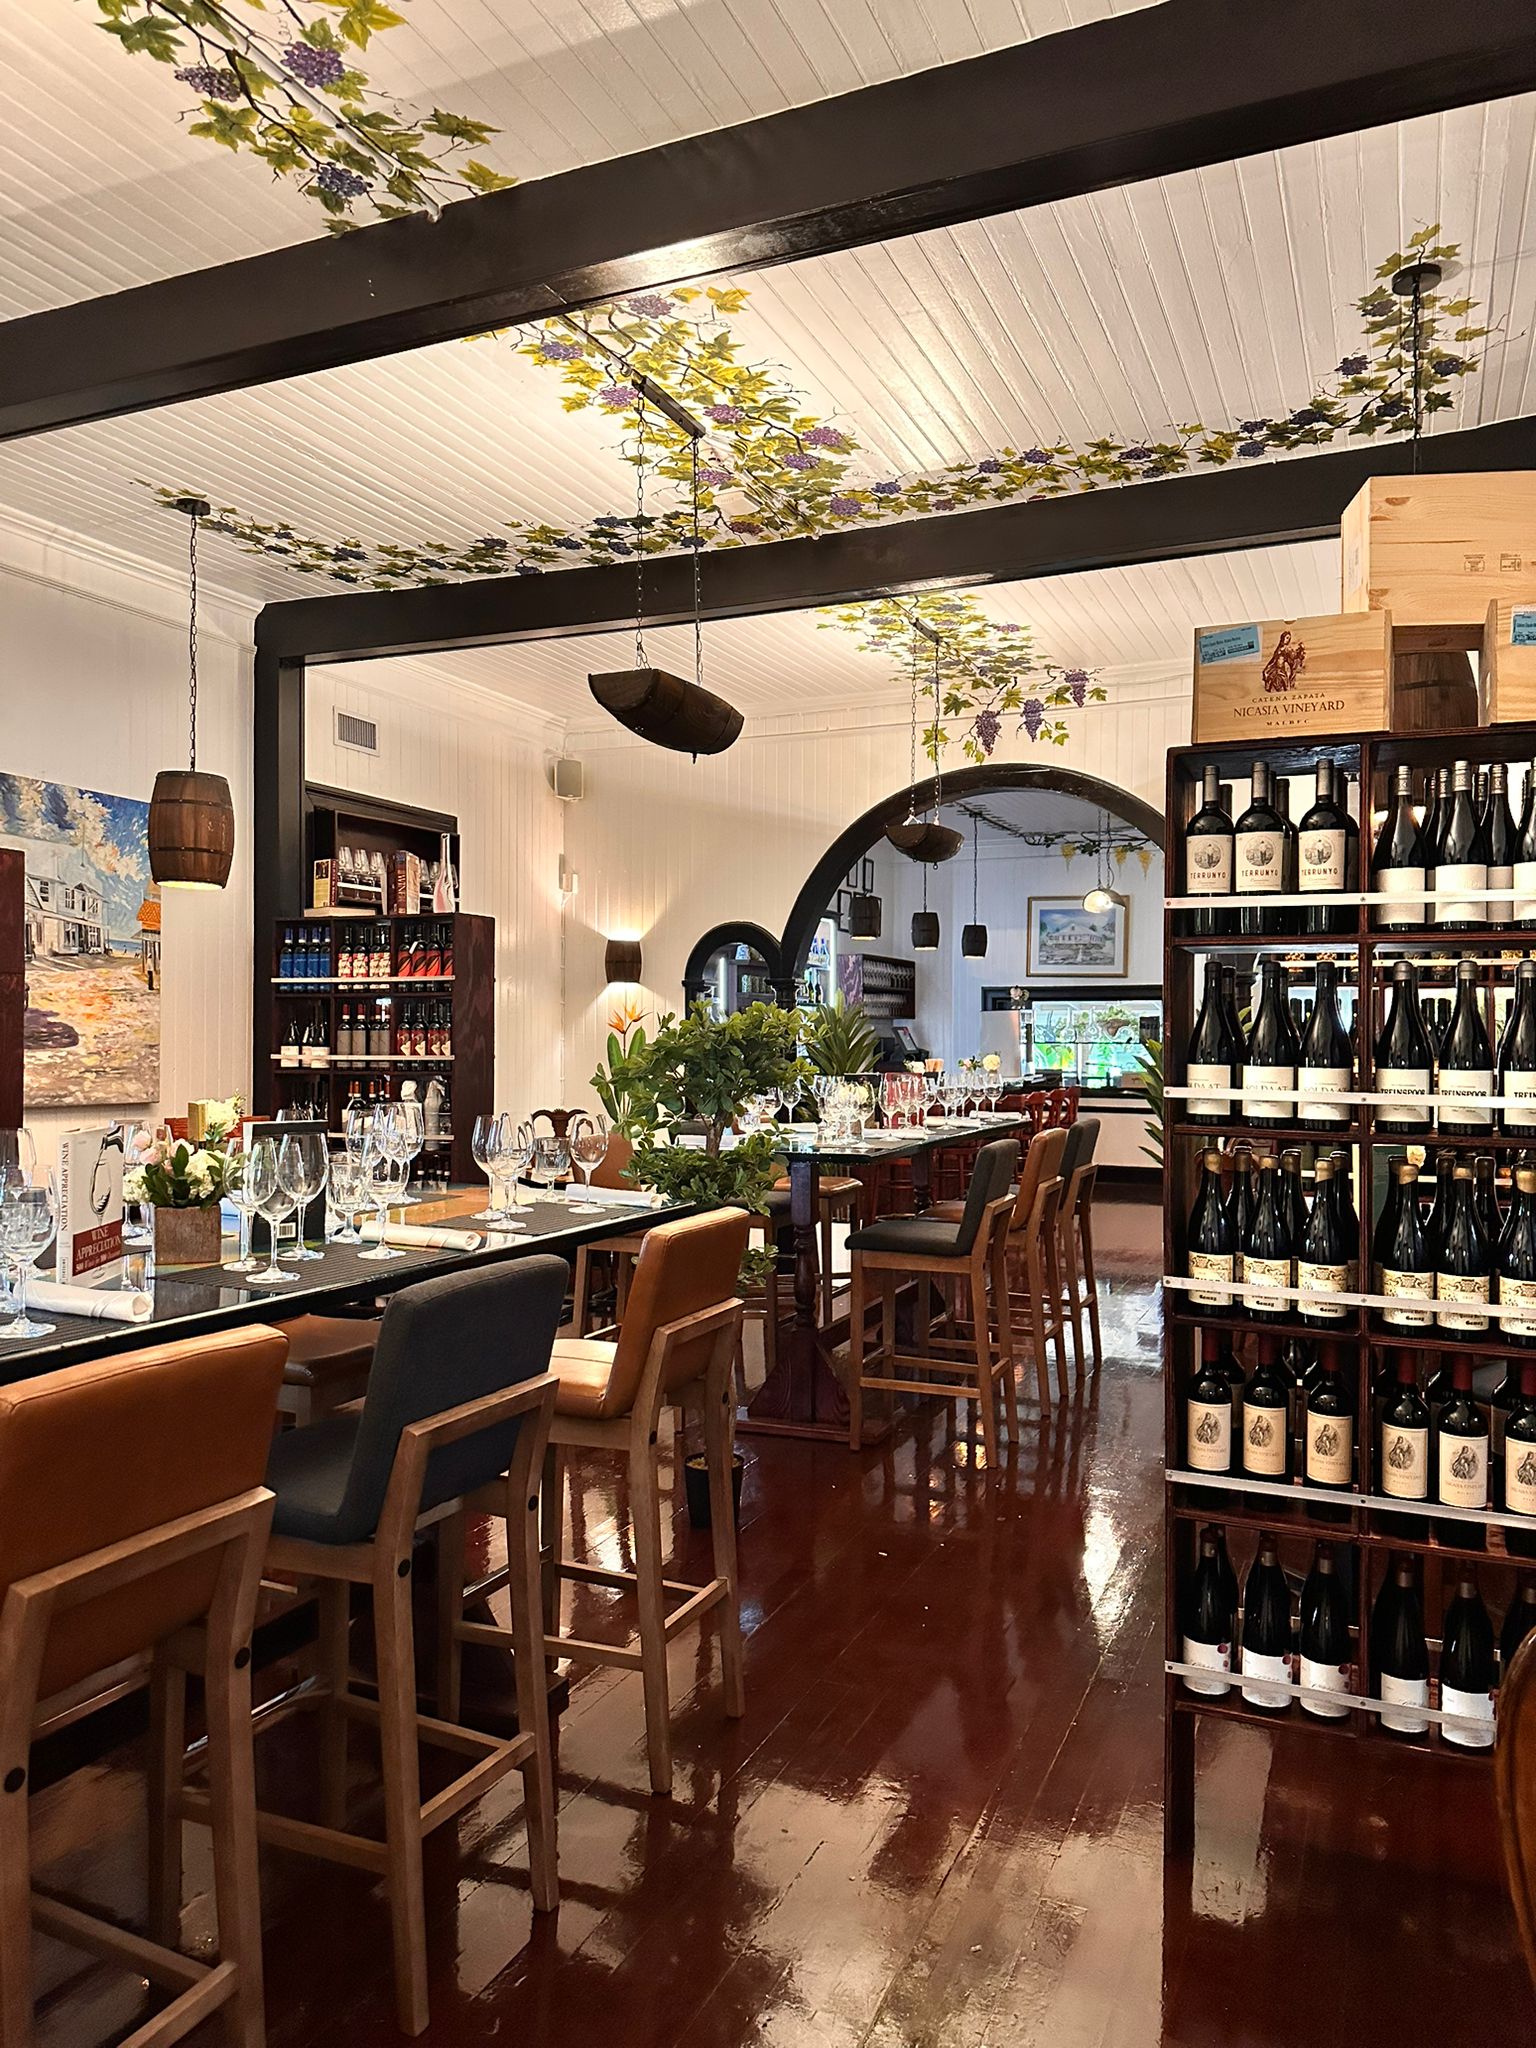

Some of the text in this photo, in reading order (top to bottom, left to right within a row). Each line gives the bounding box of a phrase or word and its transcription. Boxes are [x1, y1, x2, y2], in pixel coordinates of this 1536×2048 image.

[1252, 692, 1326, 703] CATENA ZAPATA
[1233, 700, 1345, 718] NICASIA VINEYARD
[1190, 871, 1227, 880] TERRUNYO
[1241, 868, 1279, 877] TERRUNYO
[1301, 867, 1339, 876] TERRUNYO
[60, 1142, 69, 1232] WINE APPRECIATION
[91, 1225, 109, 1240] WINE
[76, 1235, 121, 1261] APPRECIATION
